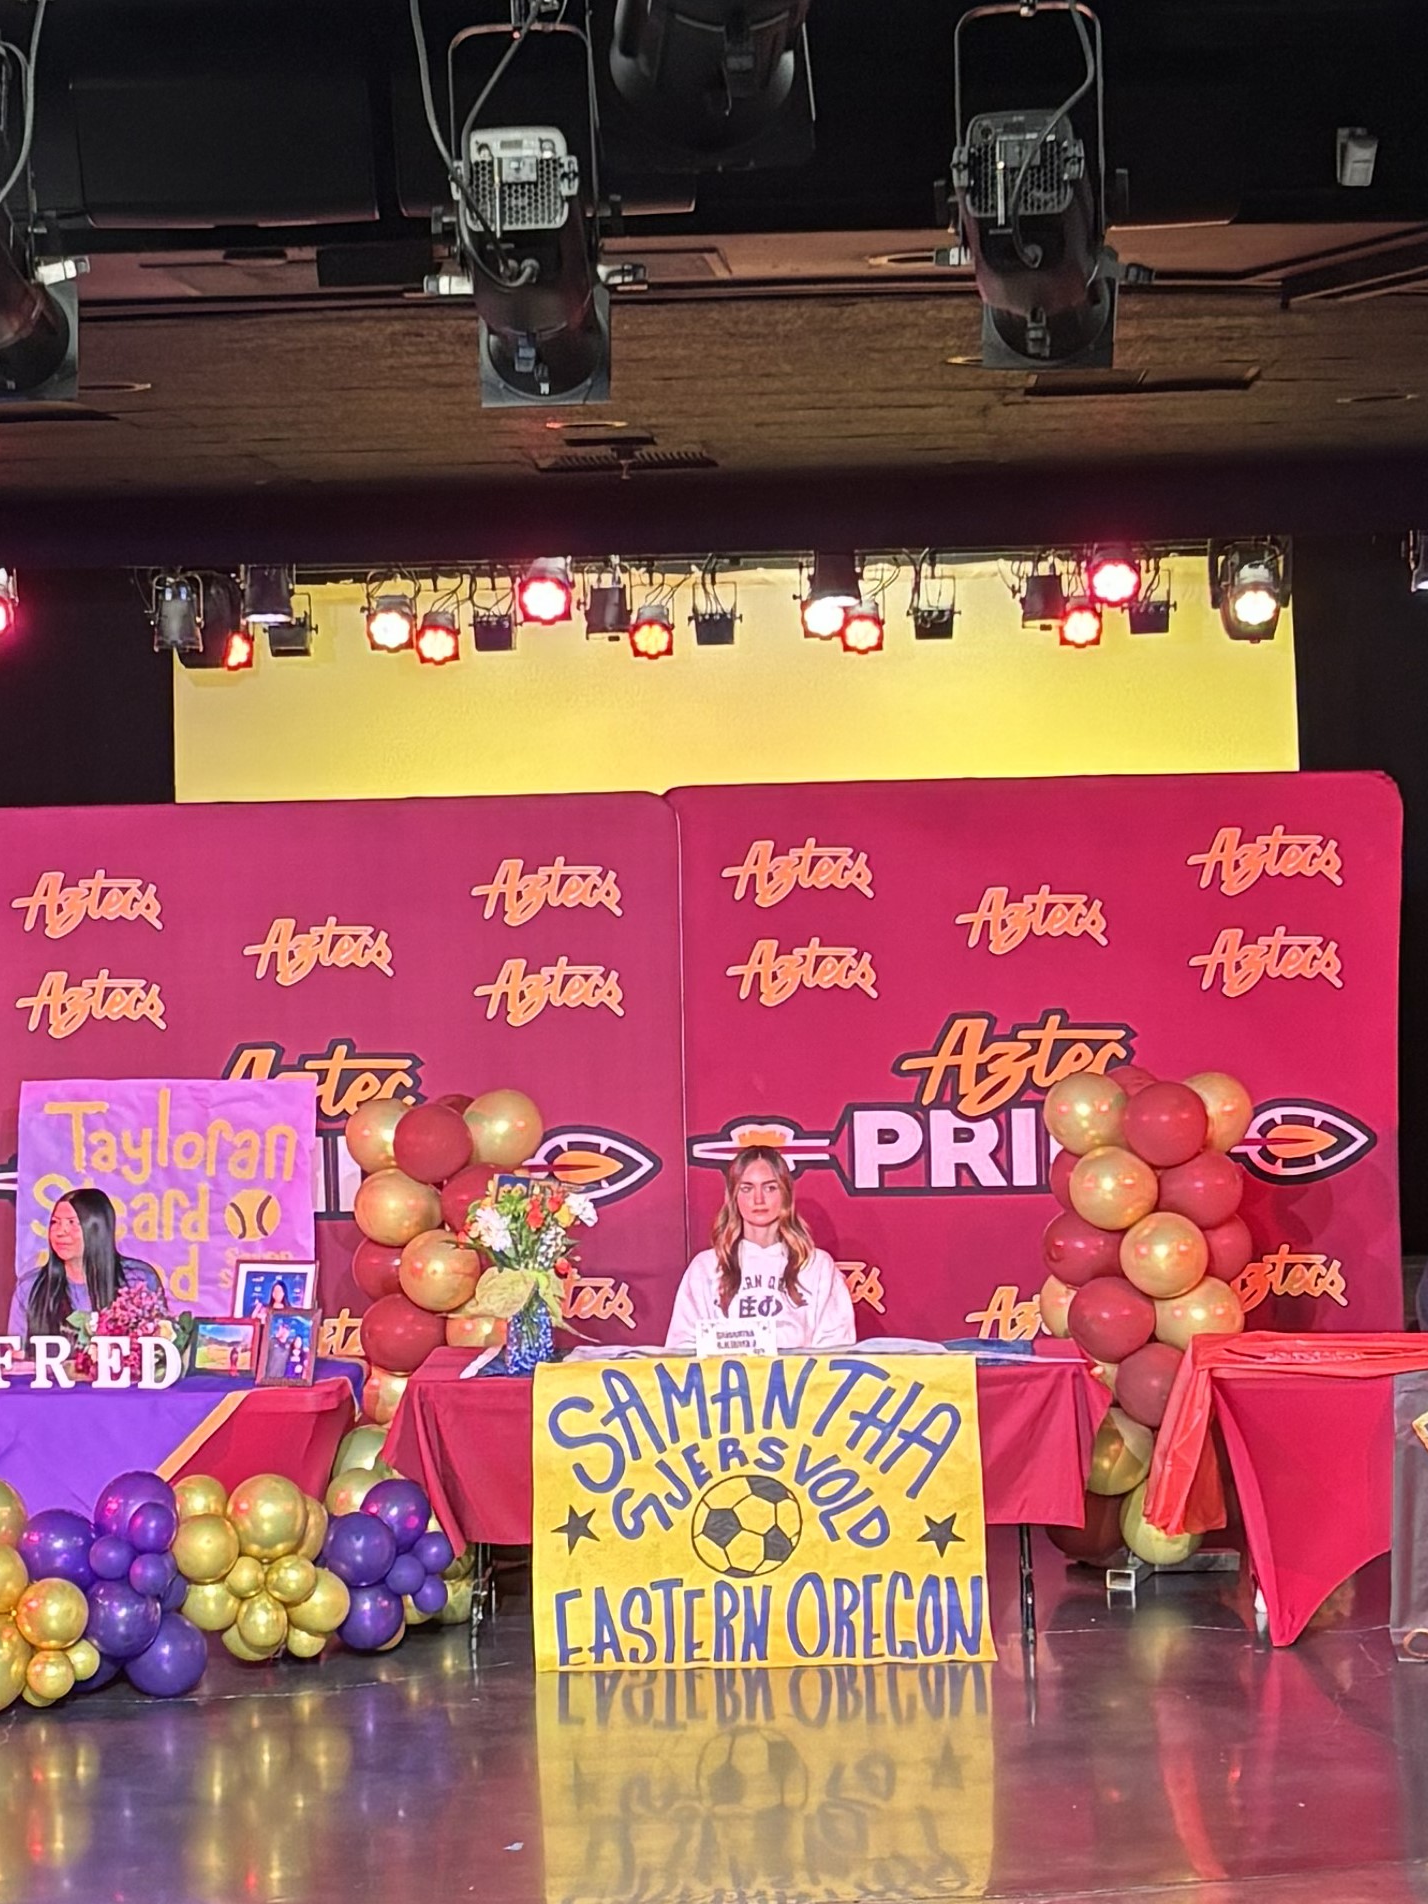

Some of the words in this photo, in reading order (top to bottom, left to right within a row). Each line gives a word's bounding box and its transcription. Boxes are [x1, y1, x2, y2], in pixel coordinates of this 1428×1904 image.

[472, 857, 623, 927] Aztecs
[721, 837, 874, 908] Aztecs
[1188, 825, 1343, 896] Aztecs
[12, 870, 163, 939] Aztecs
[955, 885, 1108, 955] Aztecs
[244, 917, 394, 986] Aztecs
[726, 937, 878, 1007] Aztecs
[1189, 926, 1343, 997] Aztecs
[16, 969, 166, 1039] Aztecs
[473, 957, 624, 1027] Aztecs
[229, 1044, 418, 1117] tec
[902, 1015, 1128, 1117] Aztec
[44, 1087, 298, 1184] Tayloran
[853, 1110, 1057, 1188] PRI
[30, 1173, 209, 1242] Sard
[562, 1269, 636, 1329] tecs
[1231, 1245, 1349, 1313] ztecs
[548, 1358, 962, 1499] SAMANTHA
[613, 1437, 890, 1548] GJERSVOLD
[555, 1578, 771, 1667] EASTERN
[787, 1570, 983, 1660] OREGON
